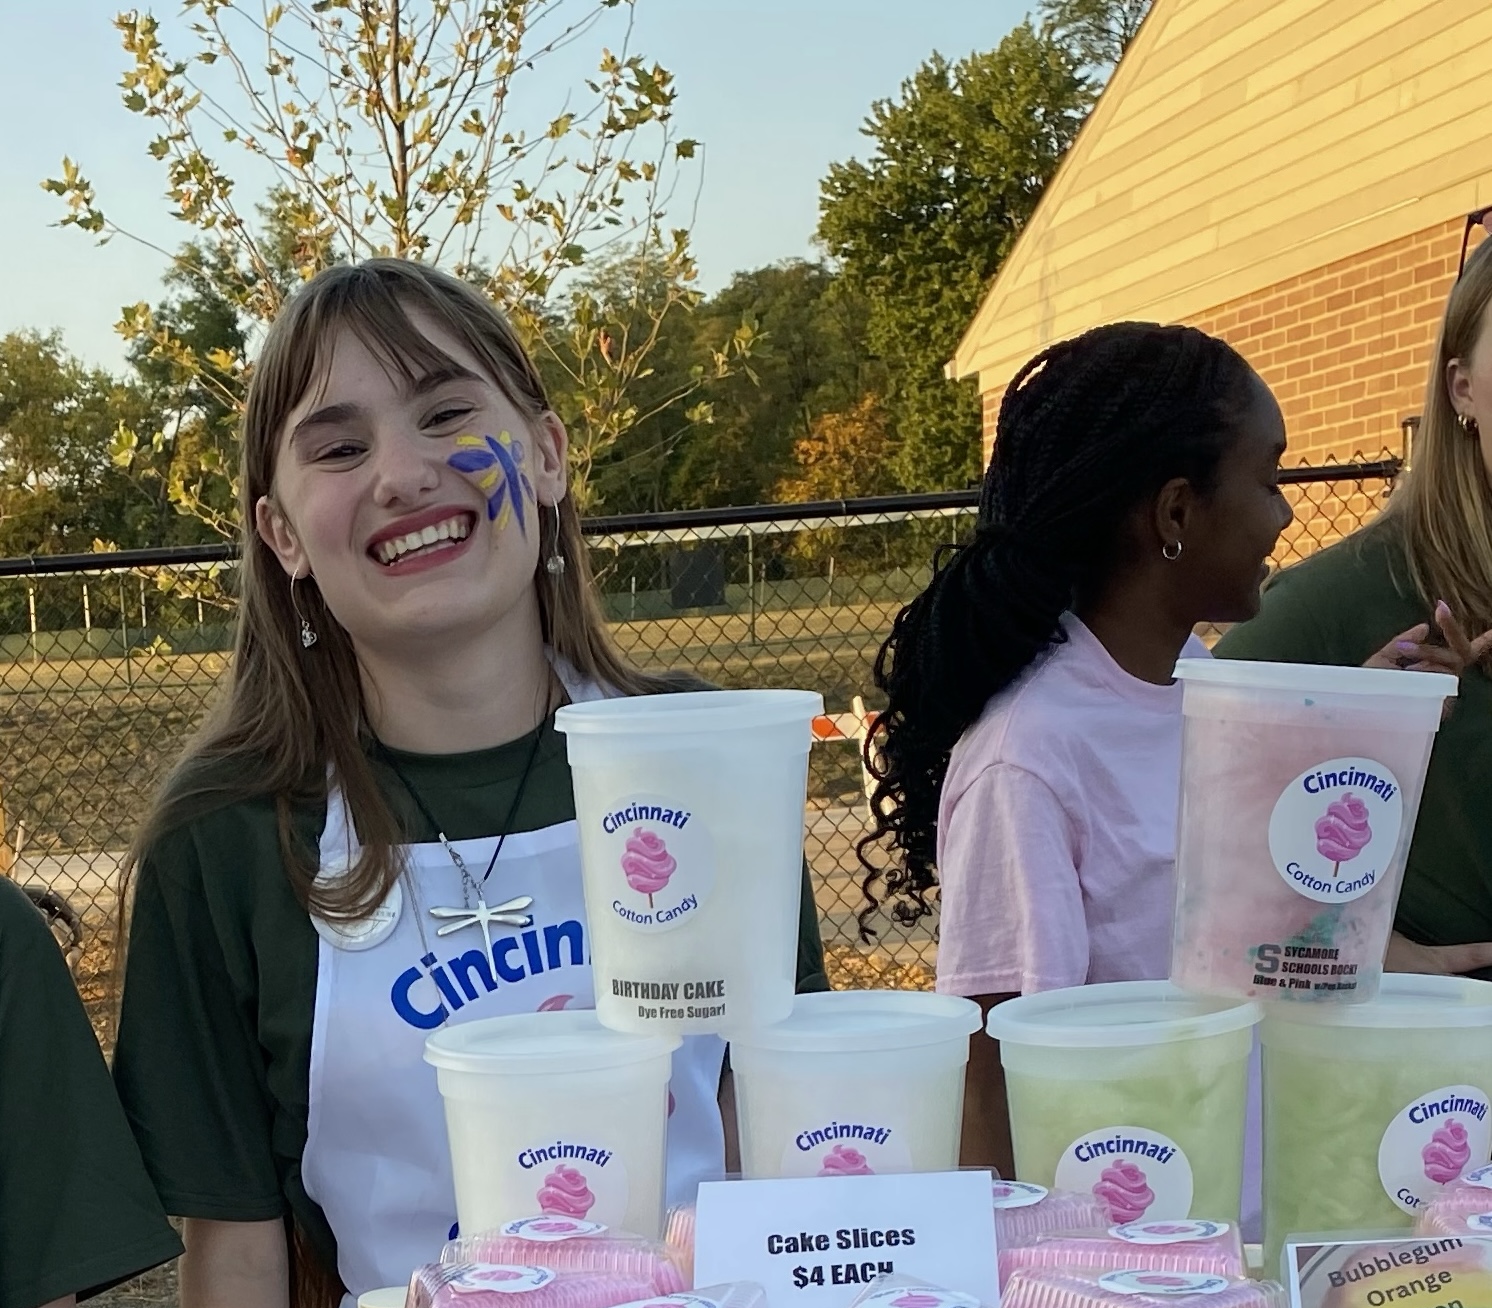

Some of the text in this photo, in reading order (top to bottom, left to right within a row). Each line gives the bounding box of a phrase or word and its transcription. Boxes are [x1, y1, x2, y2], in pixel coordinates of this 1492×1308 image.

[1303, 766, 1397, 802] Cincinnati
[603, 802, 691, 834] Cincinnati
[1286, 862, 1375, 894] Cotton Candy
[612, 894, 698, 924] Cotton Candy
[1284, 946, 1340, 960] SYCAMORE
[391, 914, 592, 1030] Cincin
[1279, 978, 1286, 988] &
[1288, 978, 1312, 989] Pink
[1282, 962, 1329, 975] SCHOOLS
[612, 979, 725, 1000] BIRTHDAY CAKE
[638, 1004, 726, 1019] Dye Free Sugar!
[1409, 1094, 1489, 1124] Cincinnati
[796, 1121, 892, 1151] Cincinnati
[1074, 1134, 1177, 1164] Cincinnati
[518, 1140, 613, 1169] Cincinnati
[1397, 1188, 1421, 1208] Cot
[767, 1228, 916, 1254] Cake Slices
[793, 1265, 825, 1289] $4
[1327, 1238, 1463, 1288] Bubblegum
[1366, 1270, 1453, 1307] Orange
